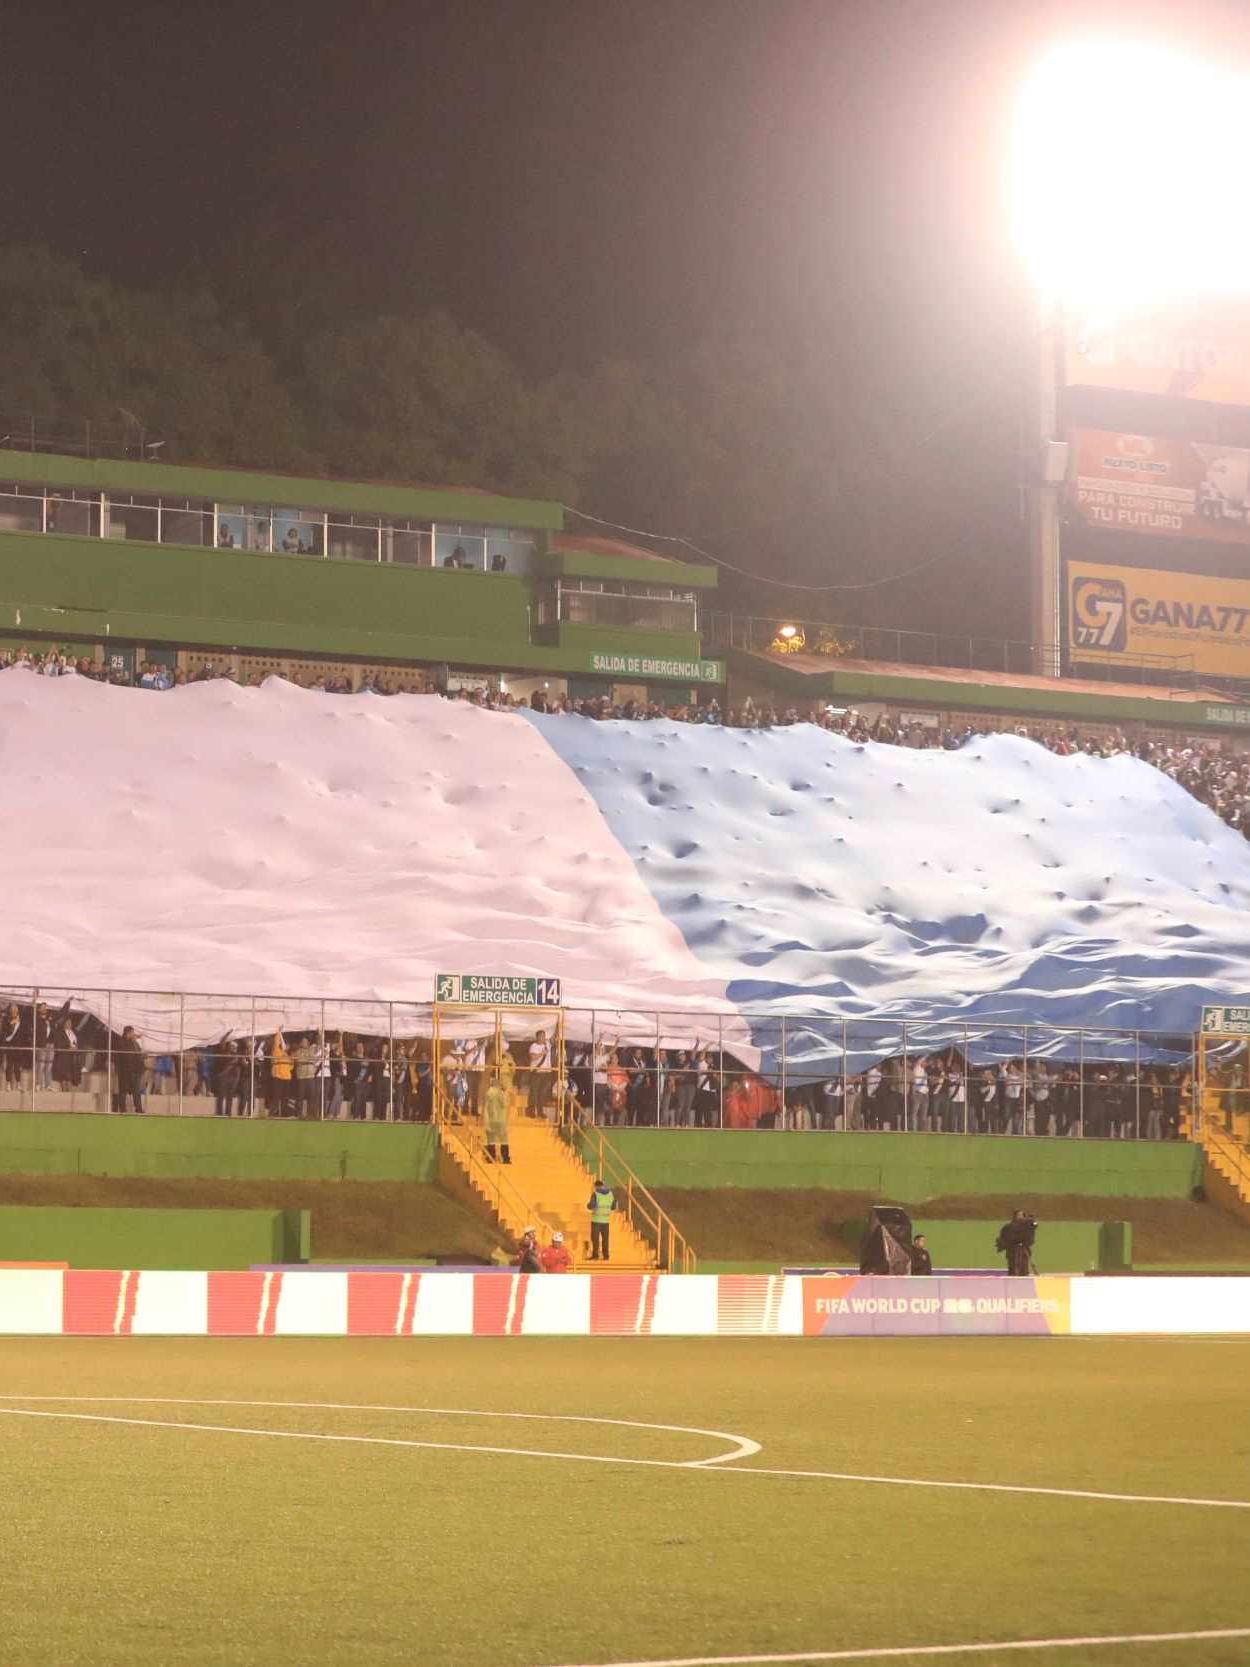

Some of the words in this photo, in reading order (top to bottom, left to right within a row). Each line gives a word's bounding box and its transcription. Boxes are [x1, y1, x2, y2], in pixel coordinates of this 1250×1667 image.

[1078, 489, 1116, 506] PARA
[1090, 505, 1114, 521] TU
[1117, 509, 1182, 529] FUTURO
[593, 655, 626, 672] SALIDA
[628, 658, 640, 673] DE
[642, 658, 701, 678] EMERGENCIA
[470, 977, 510, 990] SALIDA
[512, 978, 527, 990] DE
[538, 980, 559, 1004] 14
[462, 990, 534, 1004] EMERGENCIA
[815, 1298, 849, 1314] FIFA
[852, 1298, 907, 1314] WORLD
[910, 1298, 941, 1314] CUP
